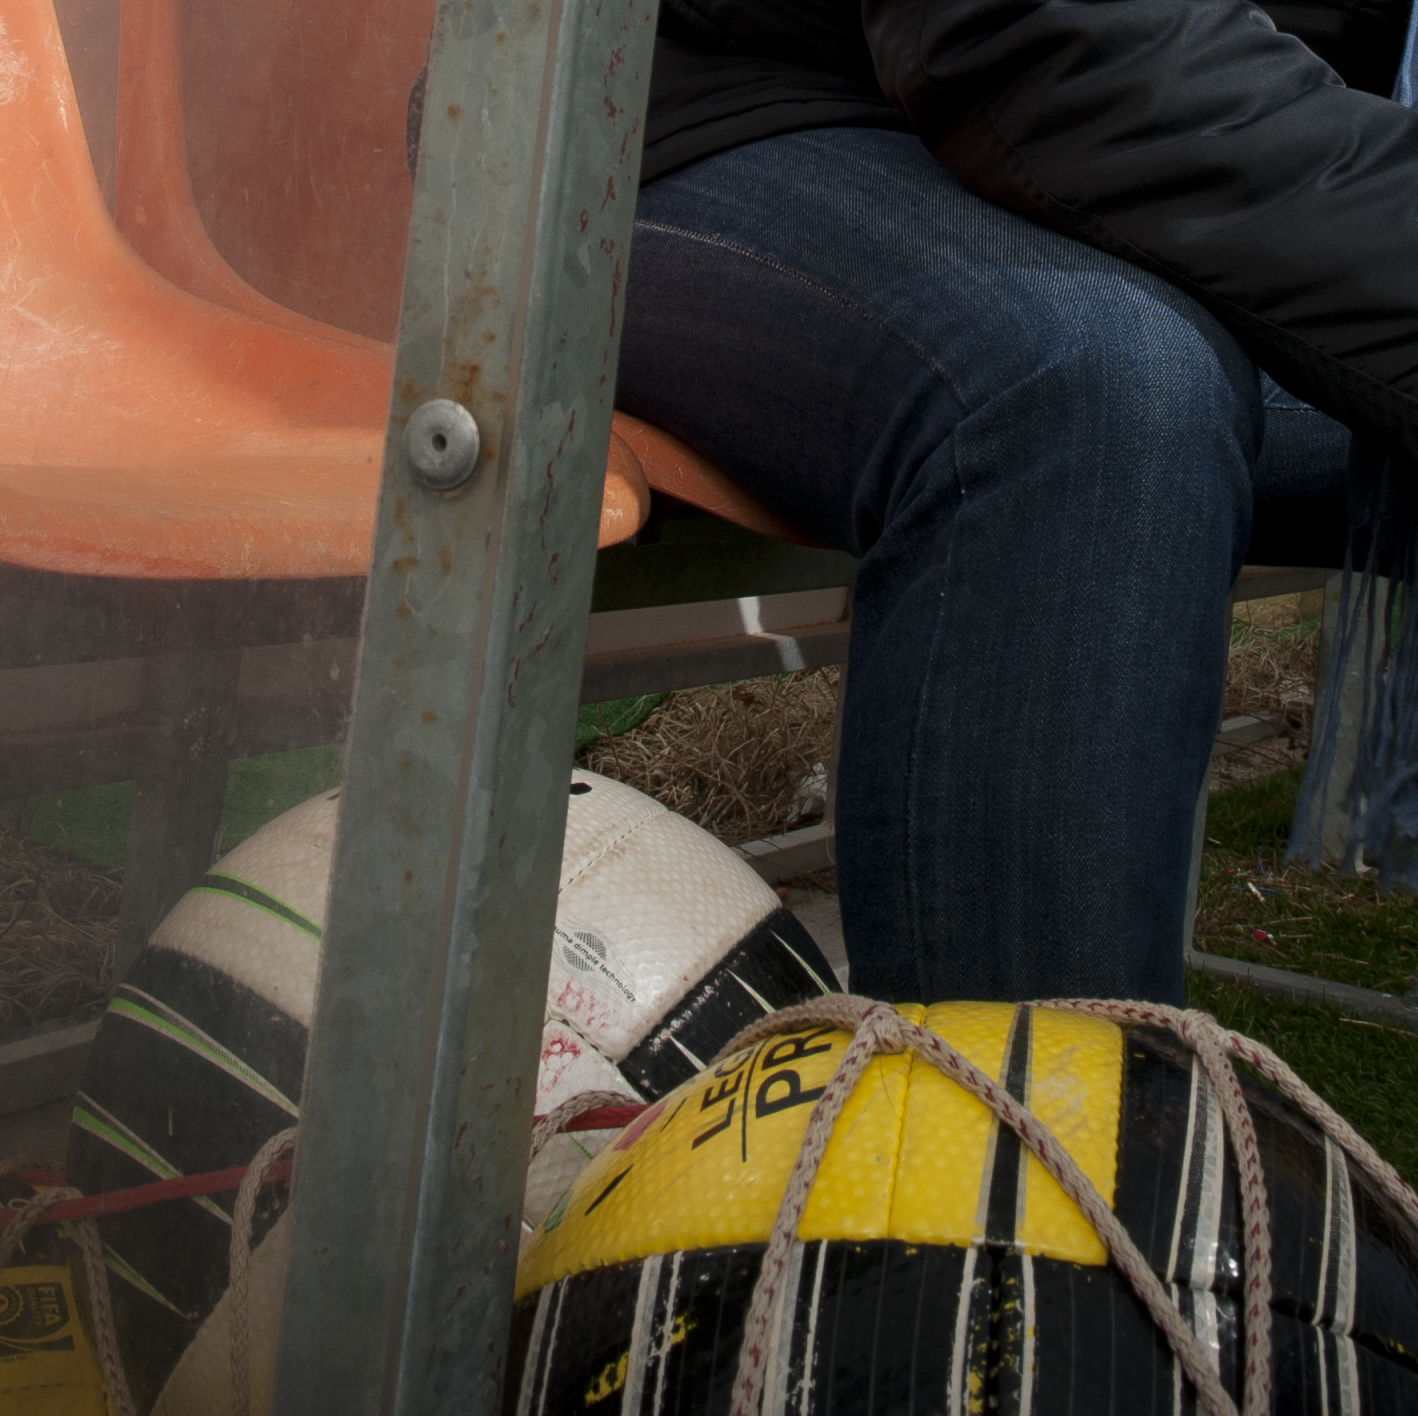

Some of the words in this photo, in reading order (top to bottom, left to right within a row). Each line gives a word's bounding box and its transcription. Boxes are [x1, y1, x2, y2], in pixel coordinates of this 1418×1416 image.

[554, 927, 573, 944] uma
[574, 942, 599, 966] dimple
[599, 964, 636, 1003] technology
[691, 1047, 755, 1151] LEG
[755, 1026, 836, 1119] PR
[27, 1286, 44, 1327] QUALITY
[37, 1286, 61, 1326] FIFA
